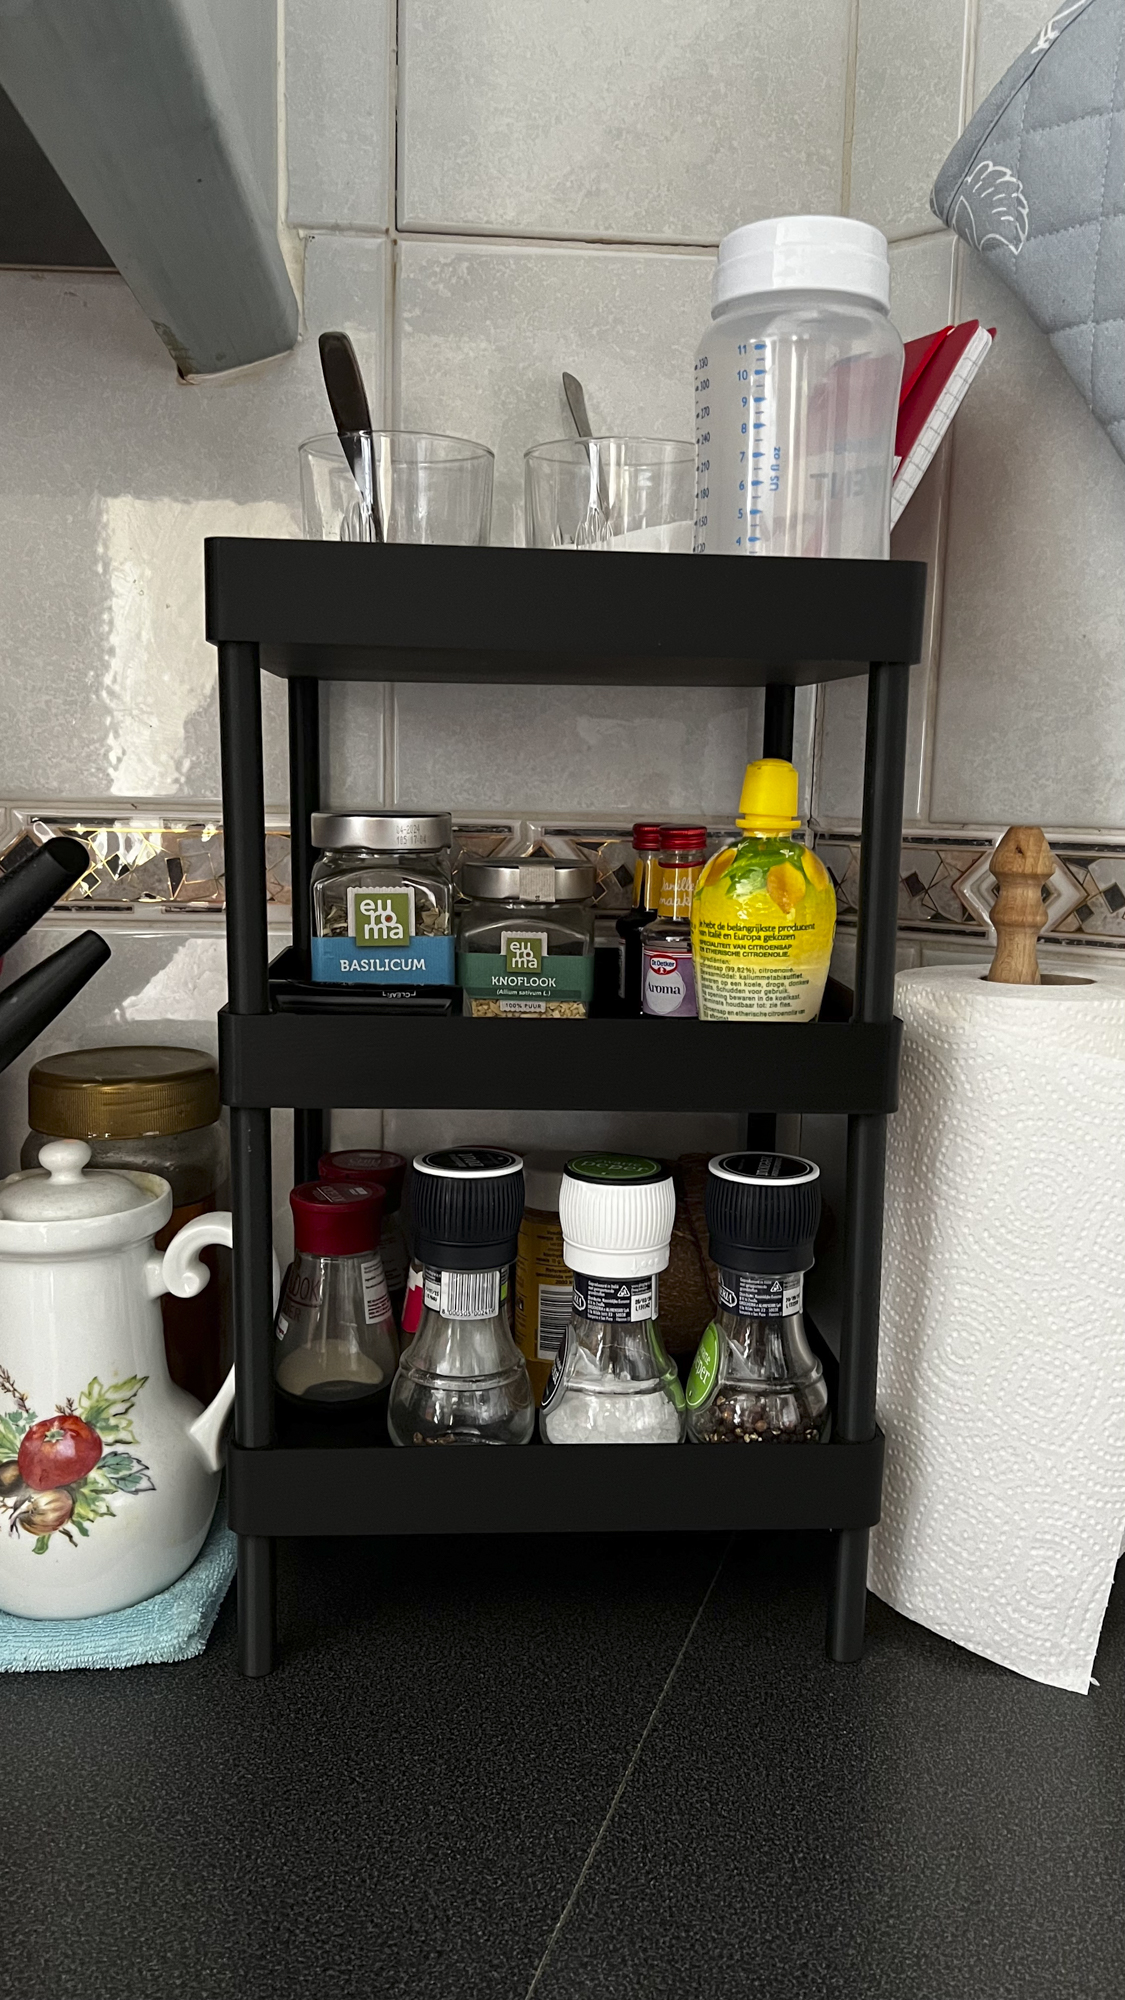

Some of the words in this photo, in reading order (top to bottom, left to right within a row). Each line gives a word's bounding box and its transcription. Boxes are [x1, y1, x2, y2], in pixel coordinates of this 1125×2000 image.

[738, 344, 747, 356] 11
[736, 369, 748, 381] 10
[741, 396, 748, 408] 9
[741, 422, 747, 434] 8
[739, 451, 746, 463] 7
[773, 446, 781, 460] oz
[739, 480, 745, 491] 6
[769, 475, 779, 492] US
[737, 508, 743, 519] 5
[736, 536, 742, 546] 4
[717, 922, 725, 931] de
[727, 922, 776, 934] belangrijkste
[733, 932, 761, 943] Europa
[763, 932, 795, 943] gekozen
[339, 958, 427, 972] BASILICUM
[491, 976, 557, 988] KNOFLOOK
[716, 985, 746, 994] Schudden
[725, 1001, 755, 1009] houdbaar
[580, 1160, 649, 1172] peper
